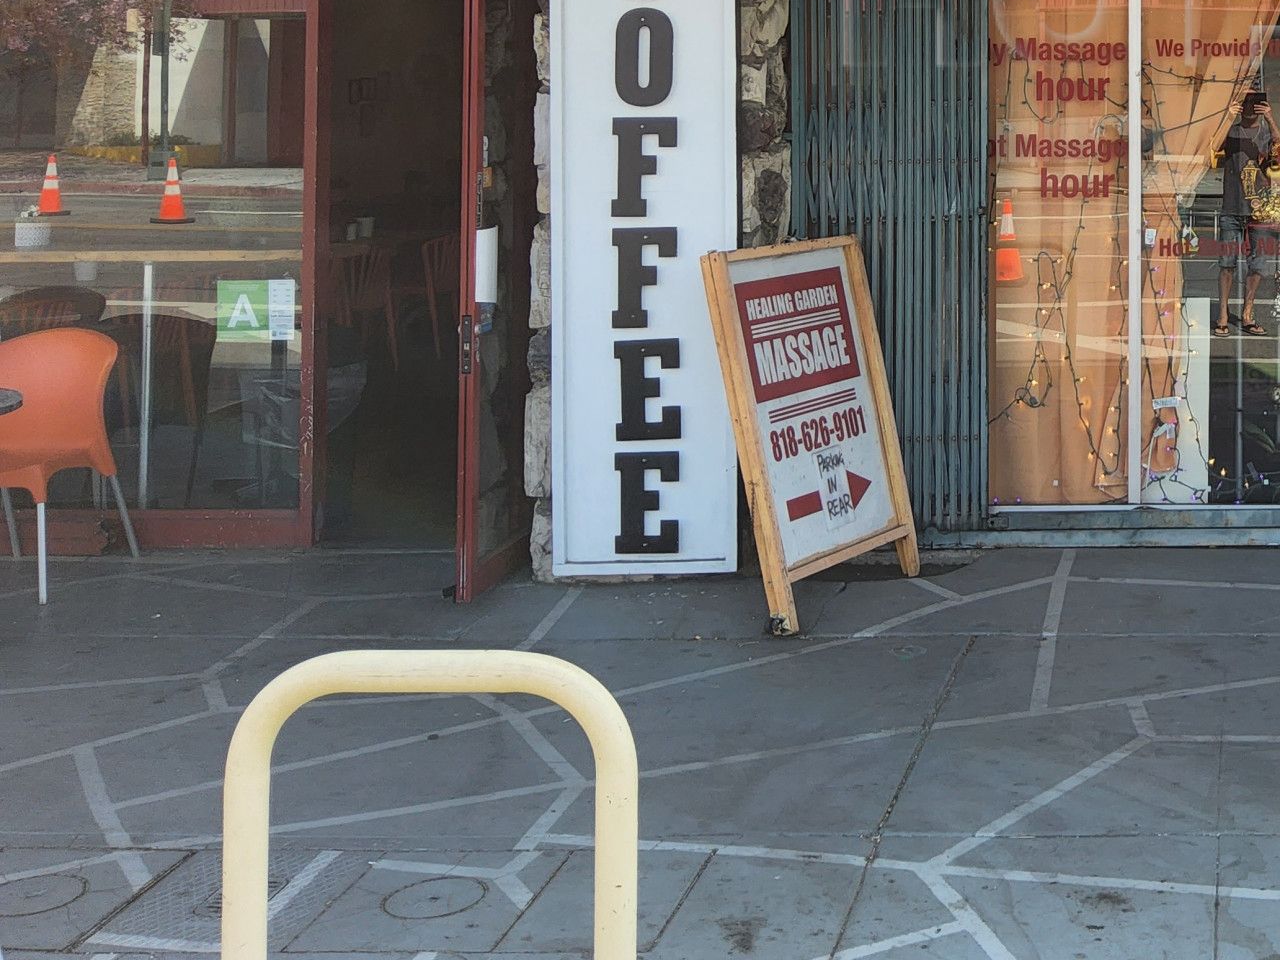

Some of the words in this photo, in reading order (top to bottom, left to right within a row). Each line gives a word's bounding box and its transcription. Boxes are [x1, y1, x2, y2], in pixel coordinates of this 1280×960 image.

[1015, 38, 1127, 66] Massage
[1156, 39, 1184, 57] We
[1191, 38, 1261, 57] Provide
[1036, 71, 1110, 102] hour
[1040, 168, 1115, 198] hour
[1159, 239, 1190, 257] Hot
[227, 293, 260, 328] A
[745, 292, 795, 321] HEALING
[794, 284, 839, 312] GARDEN
[753, 324, 851, 386] MASSAGE
[769, 405, 867, 463] 818-626-9101
[827, 474, 837, 494] IN
[827, 493, 853, 521] REAR
